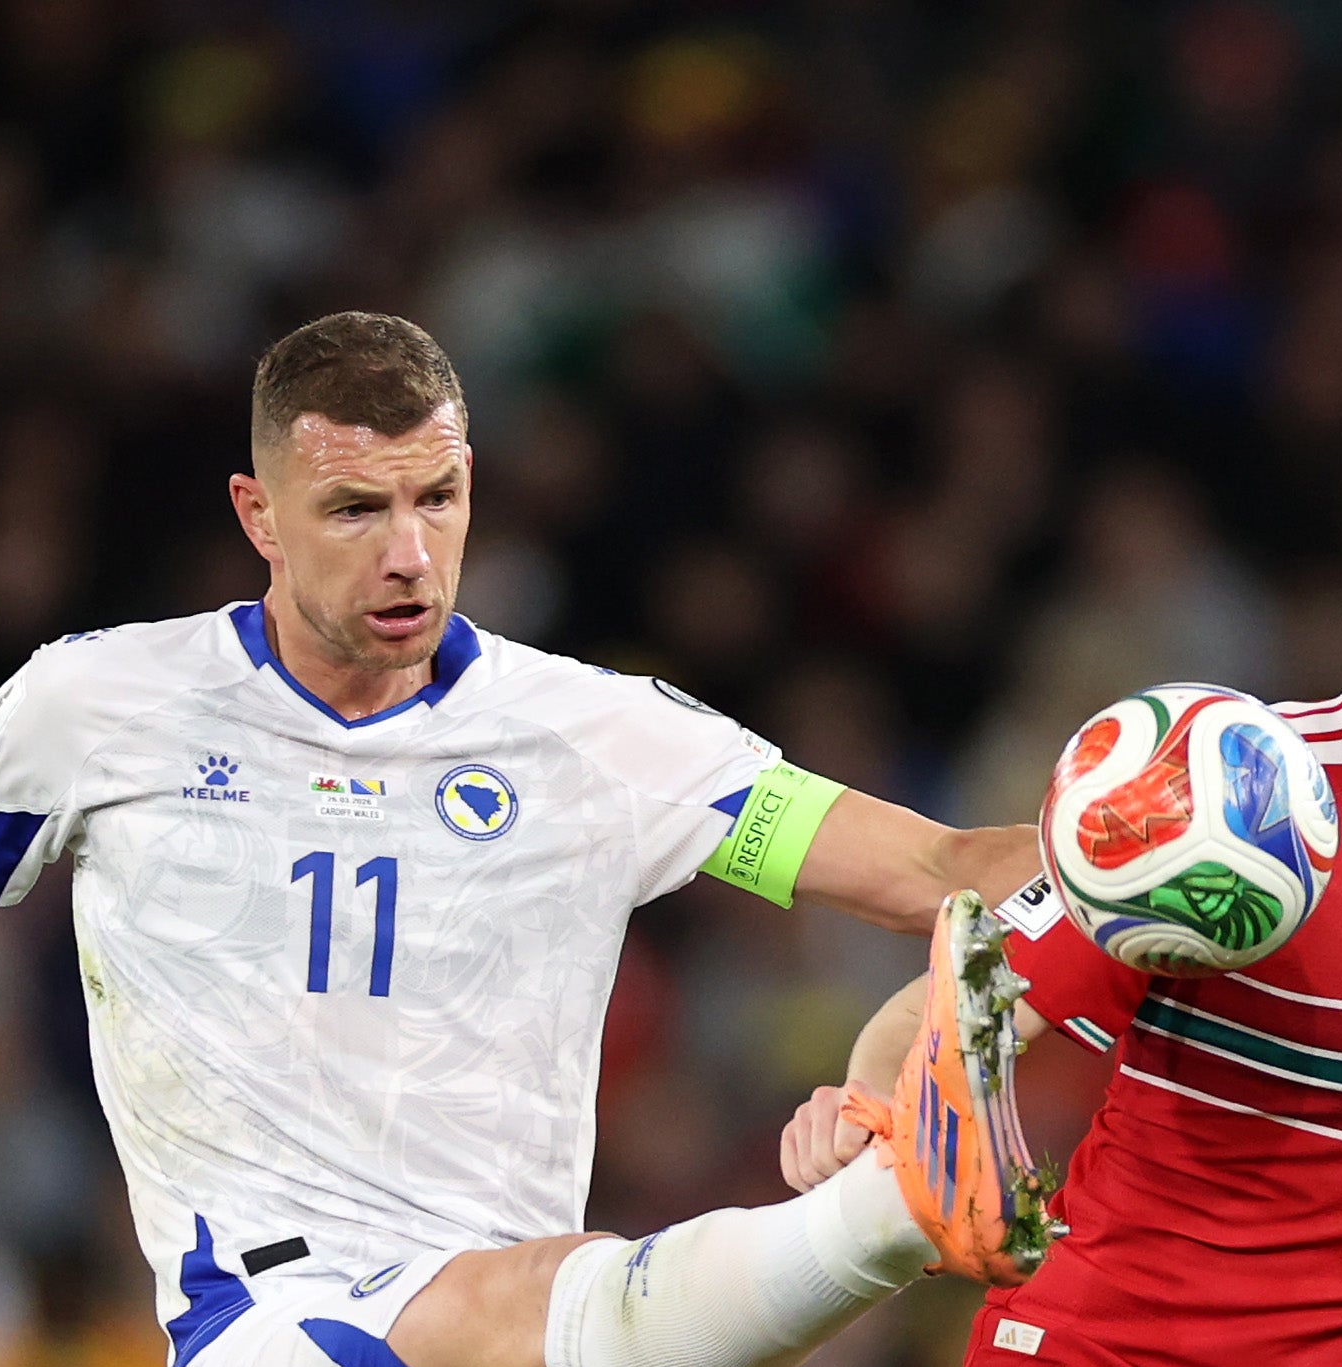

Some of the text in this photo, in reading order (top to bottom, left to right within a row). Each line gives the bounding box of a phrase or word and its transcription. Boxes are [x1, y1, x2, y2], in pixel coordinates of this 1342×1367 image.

[182, 786, 250, 802] KELME
[353, 810, 380, 819] WALES
[737, 789, 785, 868] RESPECT
[290, 850, 398, 998] 11
